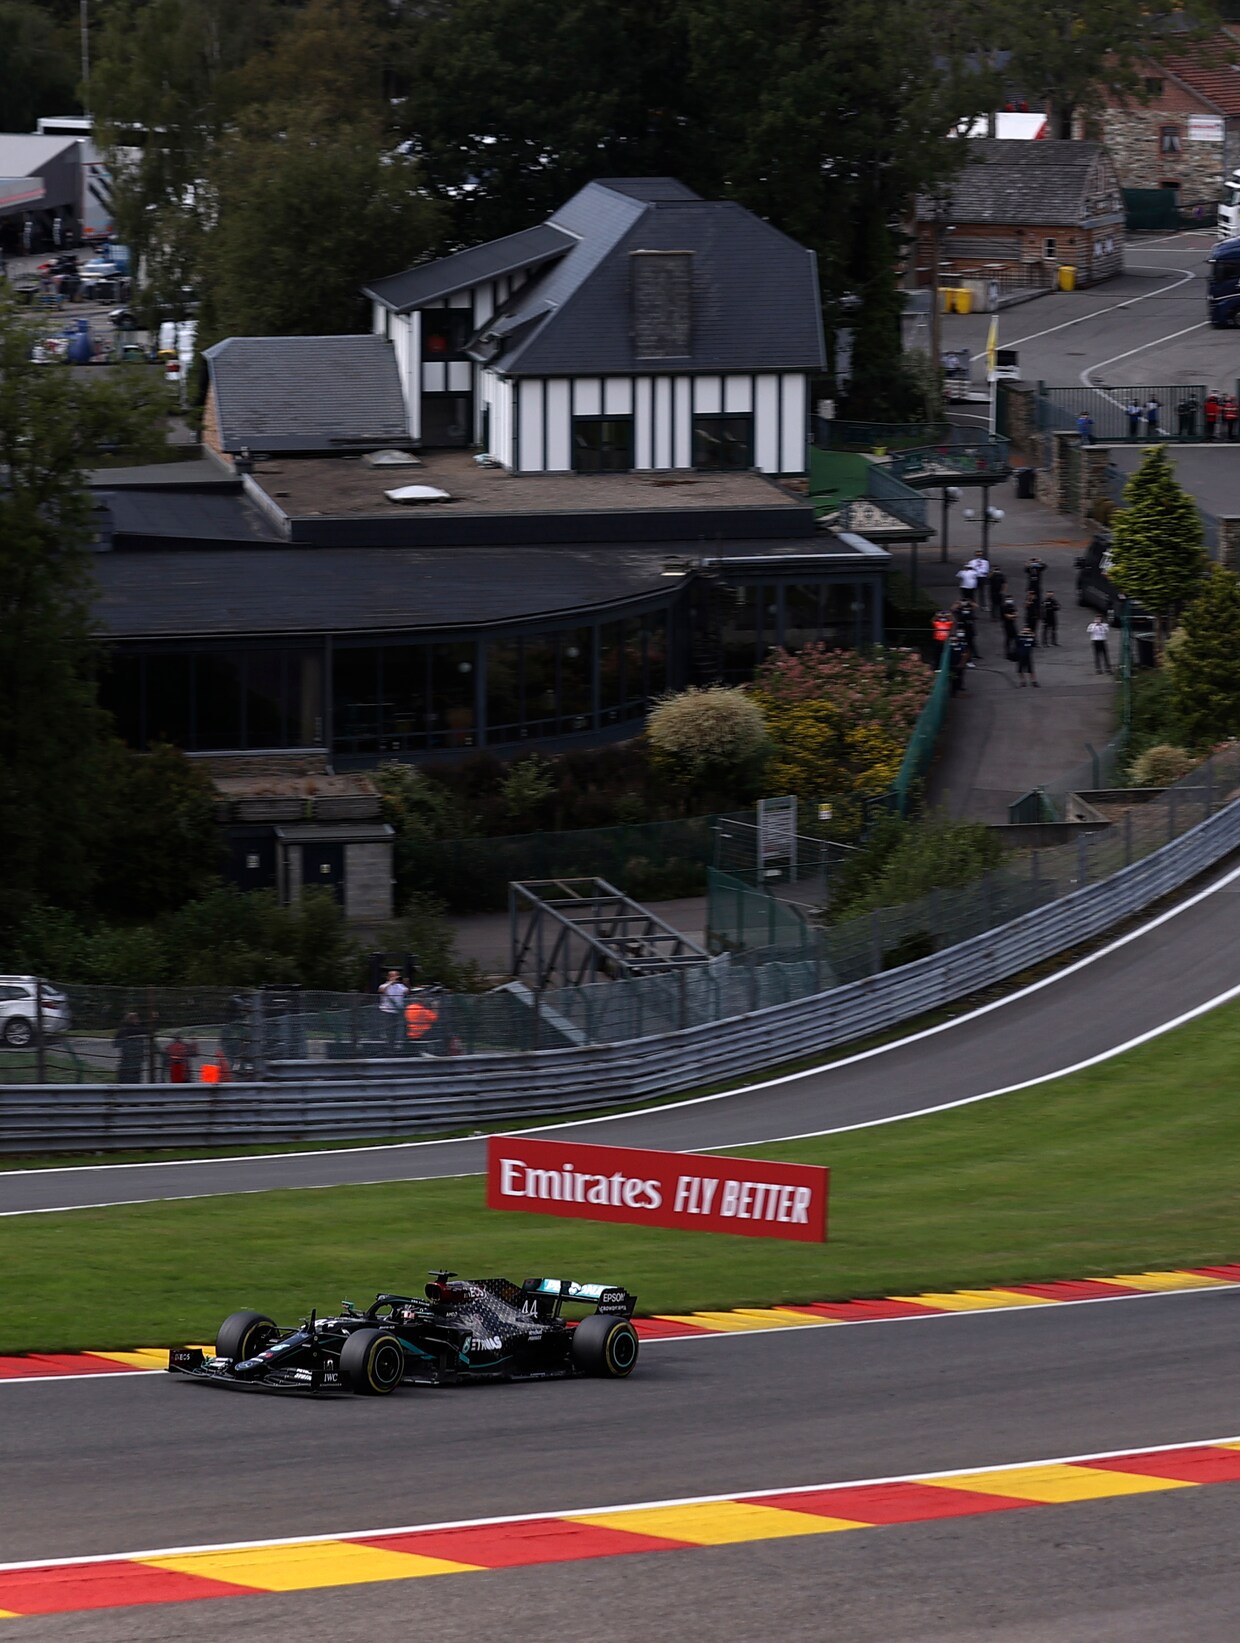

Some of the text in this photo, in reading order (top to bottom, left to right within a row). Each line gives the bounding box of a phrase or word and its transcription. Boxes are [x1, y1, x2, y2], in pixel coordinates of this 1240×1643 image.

[499, 1159, 812, 1224] Emirates FLY BETTER
[603, 1292, 626, 1302] EPSON
[521, 1299, 539, 1318] 44
[324, 1373, 339, 1382] IWC
